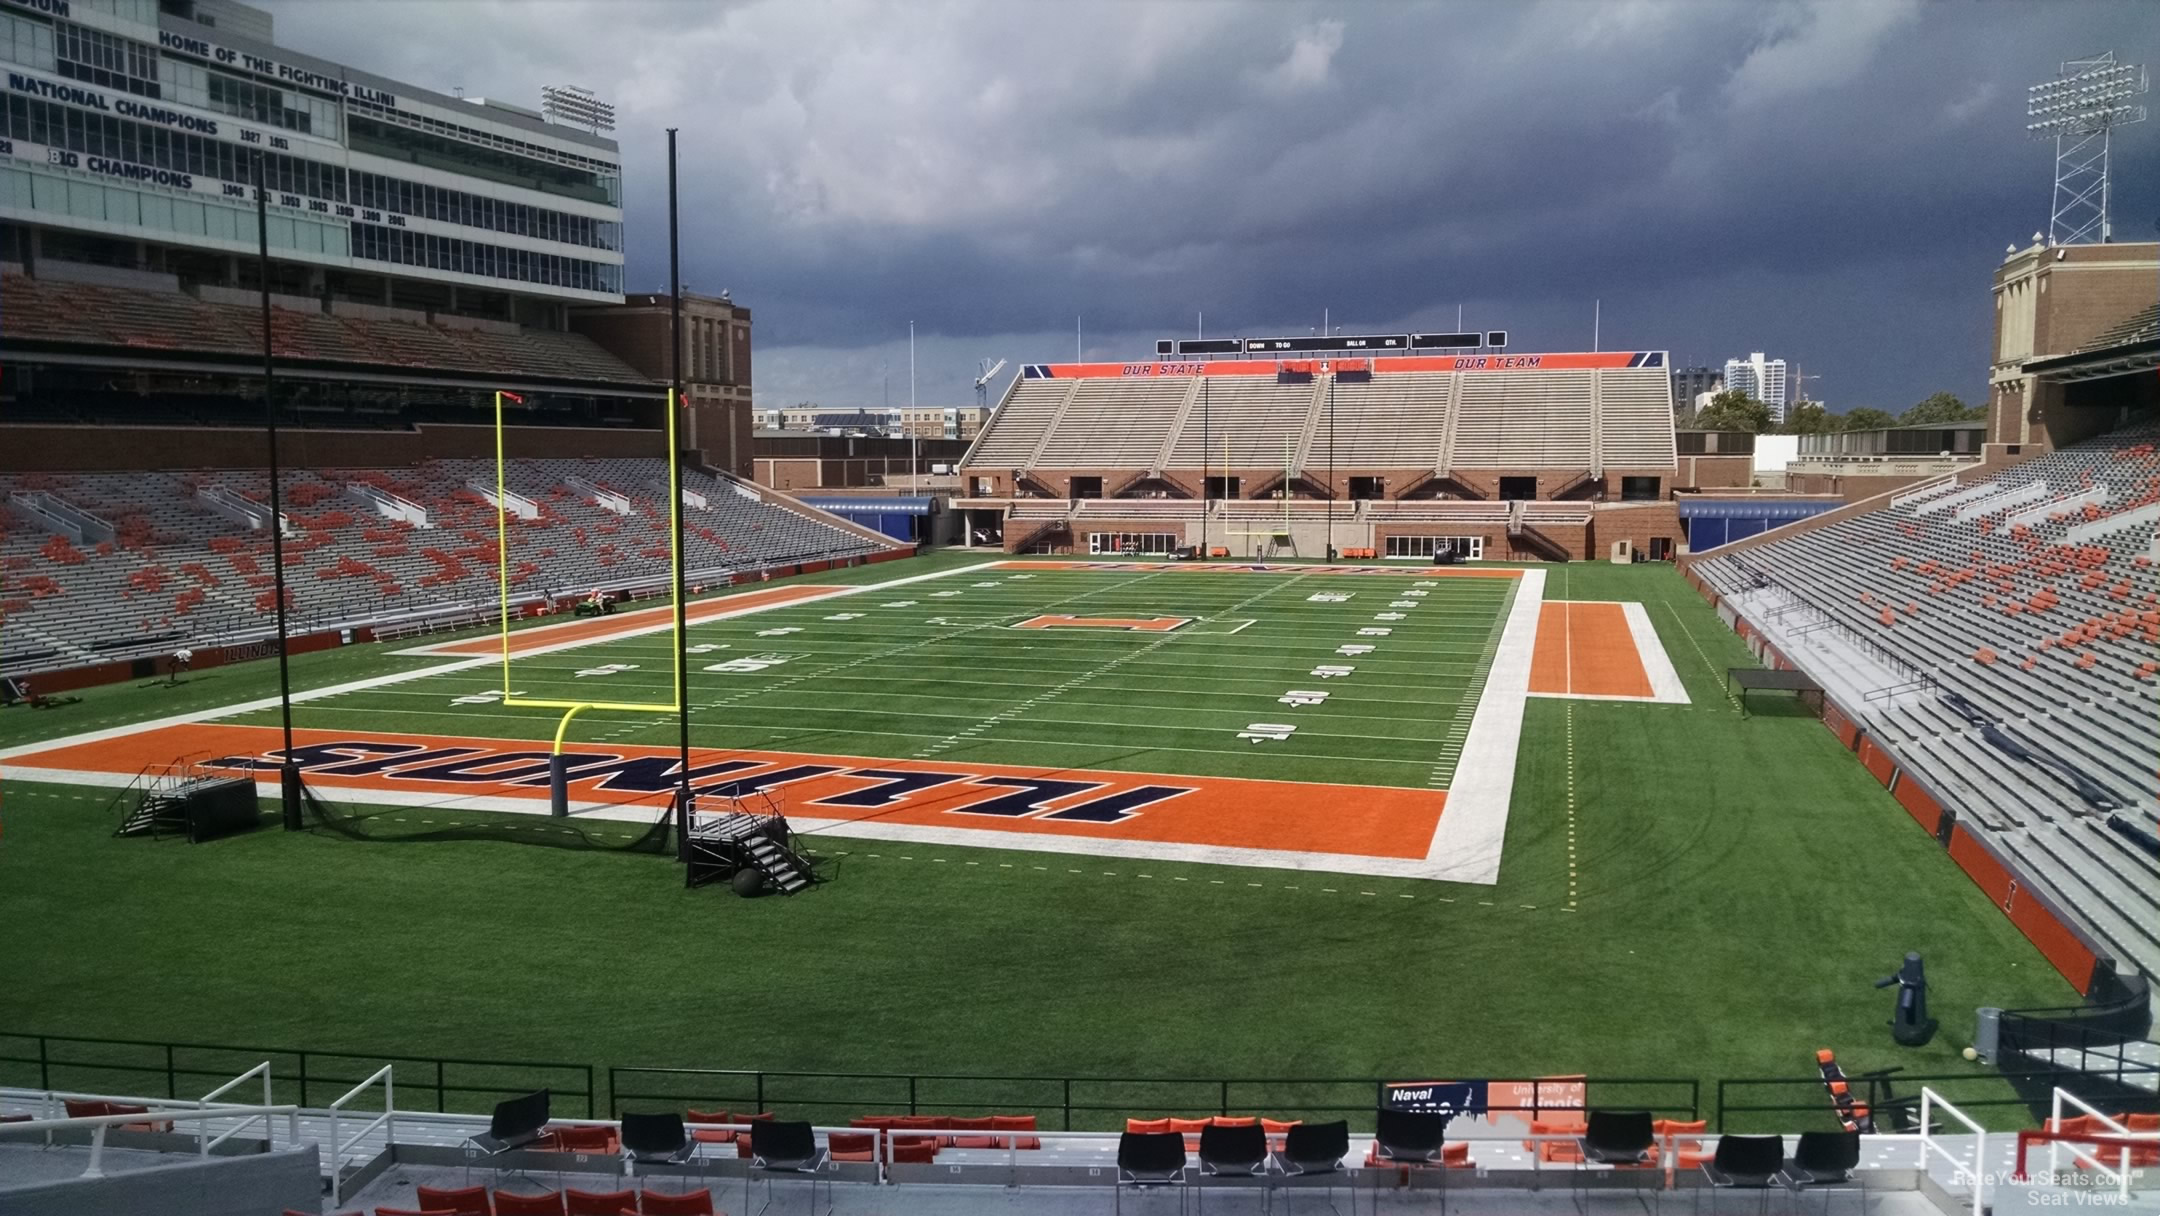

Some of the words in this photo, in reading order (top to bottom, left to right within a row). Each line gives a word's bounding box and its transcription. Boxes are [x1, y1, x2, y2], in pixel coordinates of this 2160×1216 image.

[158, 30, 210, 57] HOME
[215, 47, 237, 64] OF
[242, 54, 274, 75] THE
[279, 64, 349, 95] FIGHTING
[354, 85, 396, 107] ILLINI
[8, 72, 110, 111] NATIONAL
[115, 99, 219, 136] CHAMPIONS
[240, 129, 261, 144] 1927
[269, 135, 289, 150] 1951
[87, 156, 193, 189] CHAMPIONS
[253, 189, 272, 203] 151
[388, 214, 406, 227] 2001
[1122, 364, 1151, 376] OUR
[1159, 363, 1205, 376] STATE
[1453, 356, 1487, 370] OUR
[1495, 356, 1541, 370] TEAM
[224, 645, 281, 663] ILLINOIS
[196, 741, 1202, 824] ILLINOIS
[1392, 1087, 1433, 1102] Naval
[1570, 1081, 1583, 1093] of
[1520, 1095, 1583, 1108] Ilinois
